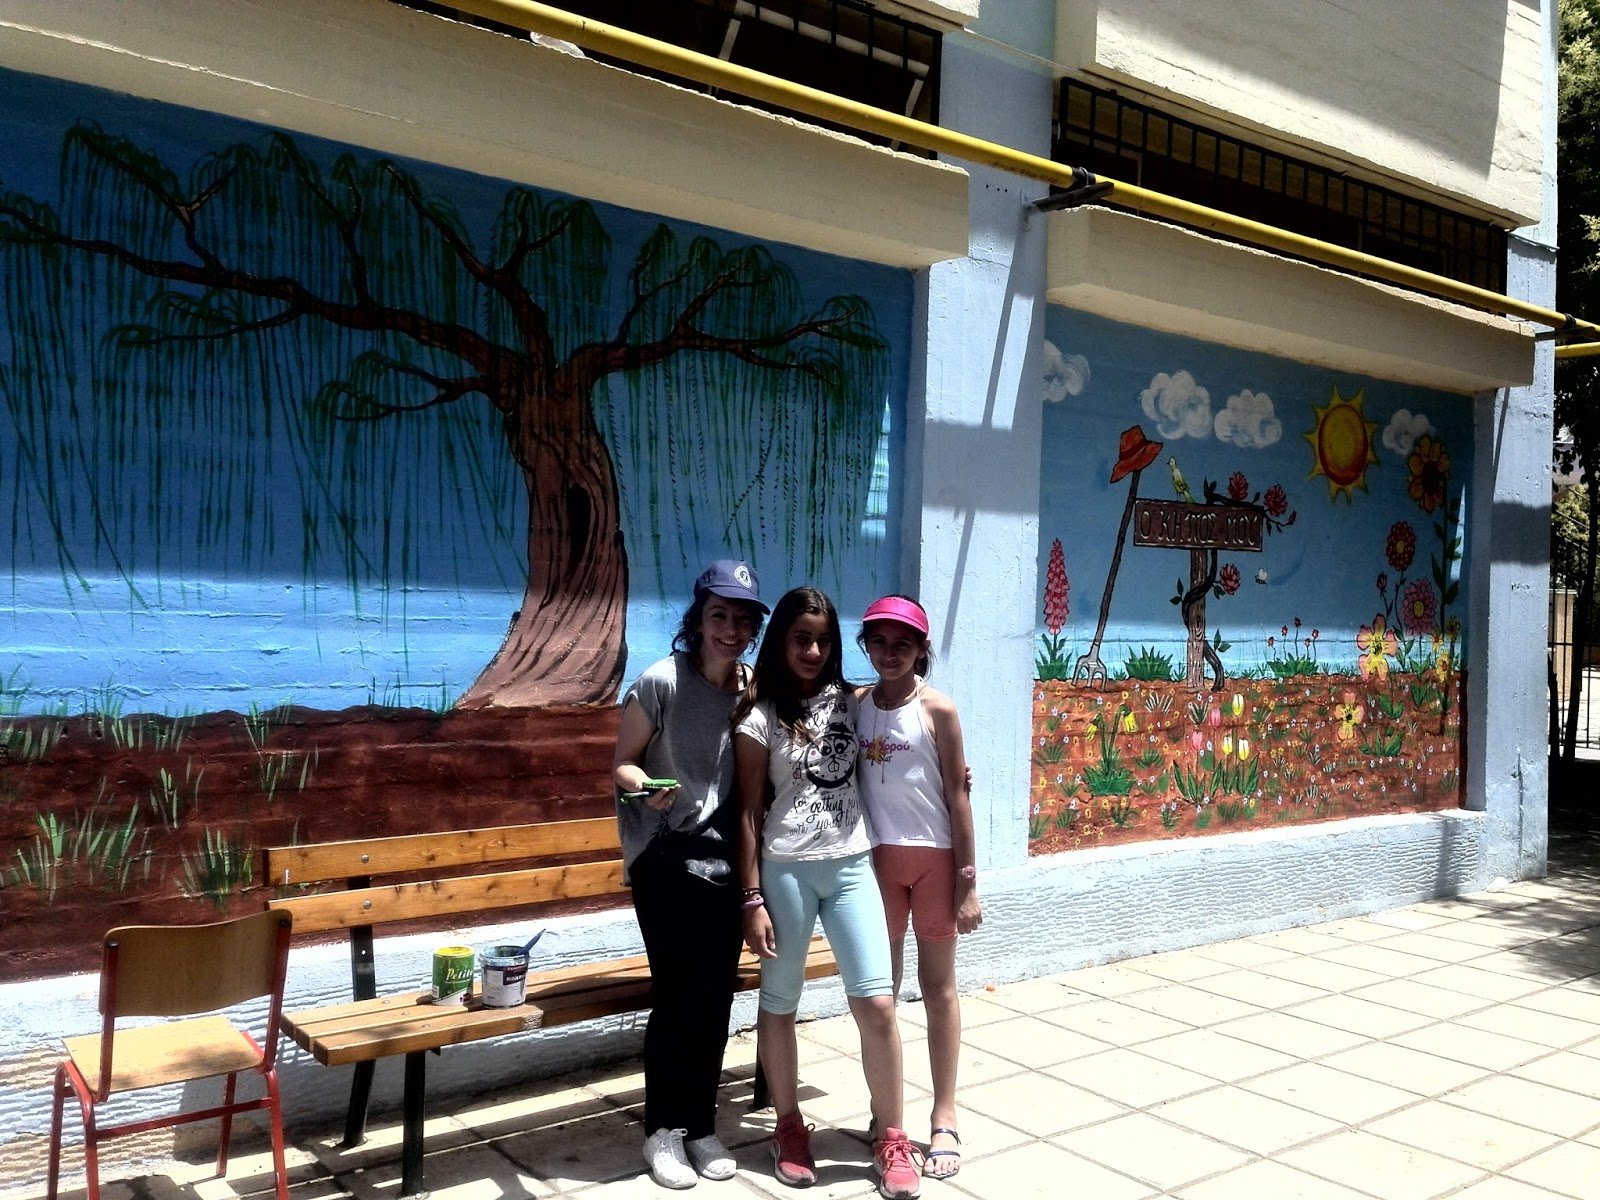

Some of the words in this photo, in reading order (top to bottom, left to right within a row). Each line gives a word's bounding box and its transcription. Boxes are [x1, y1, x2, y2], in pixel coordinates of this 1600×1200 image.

[1158, 508, 1219, 544] ΚΗΠΟΣ
[1224, 512, 1259, 546] ΜΟΥ
[805, 794, 845, 824] getting
